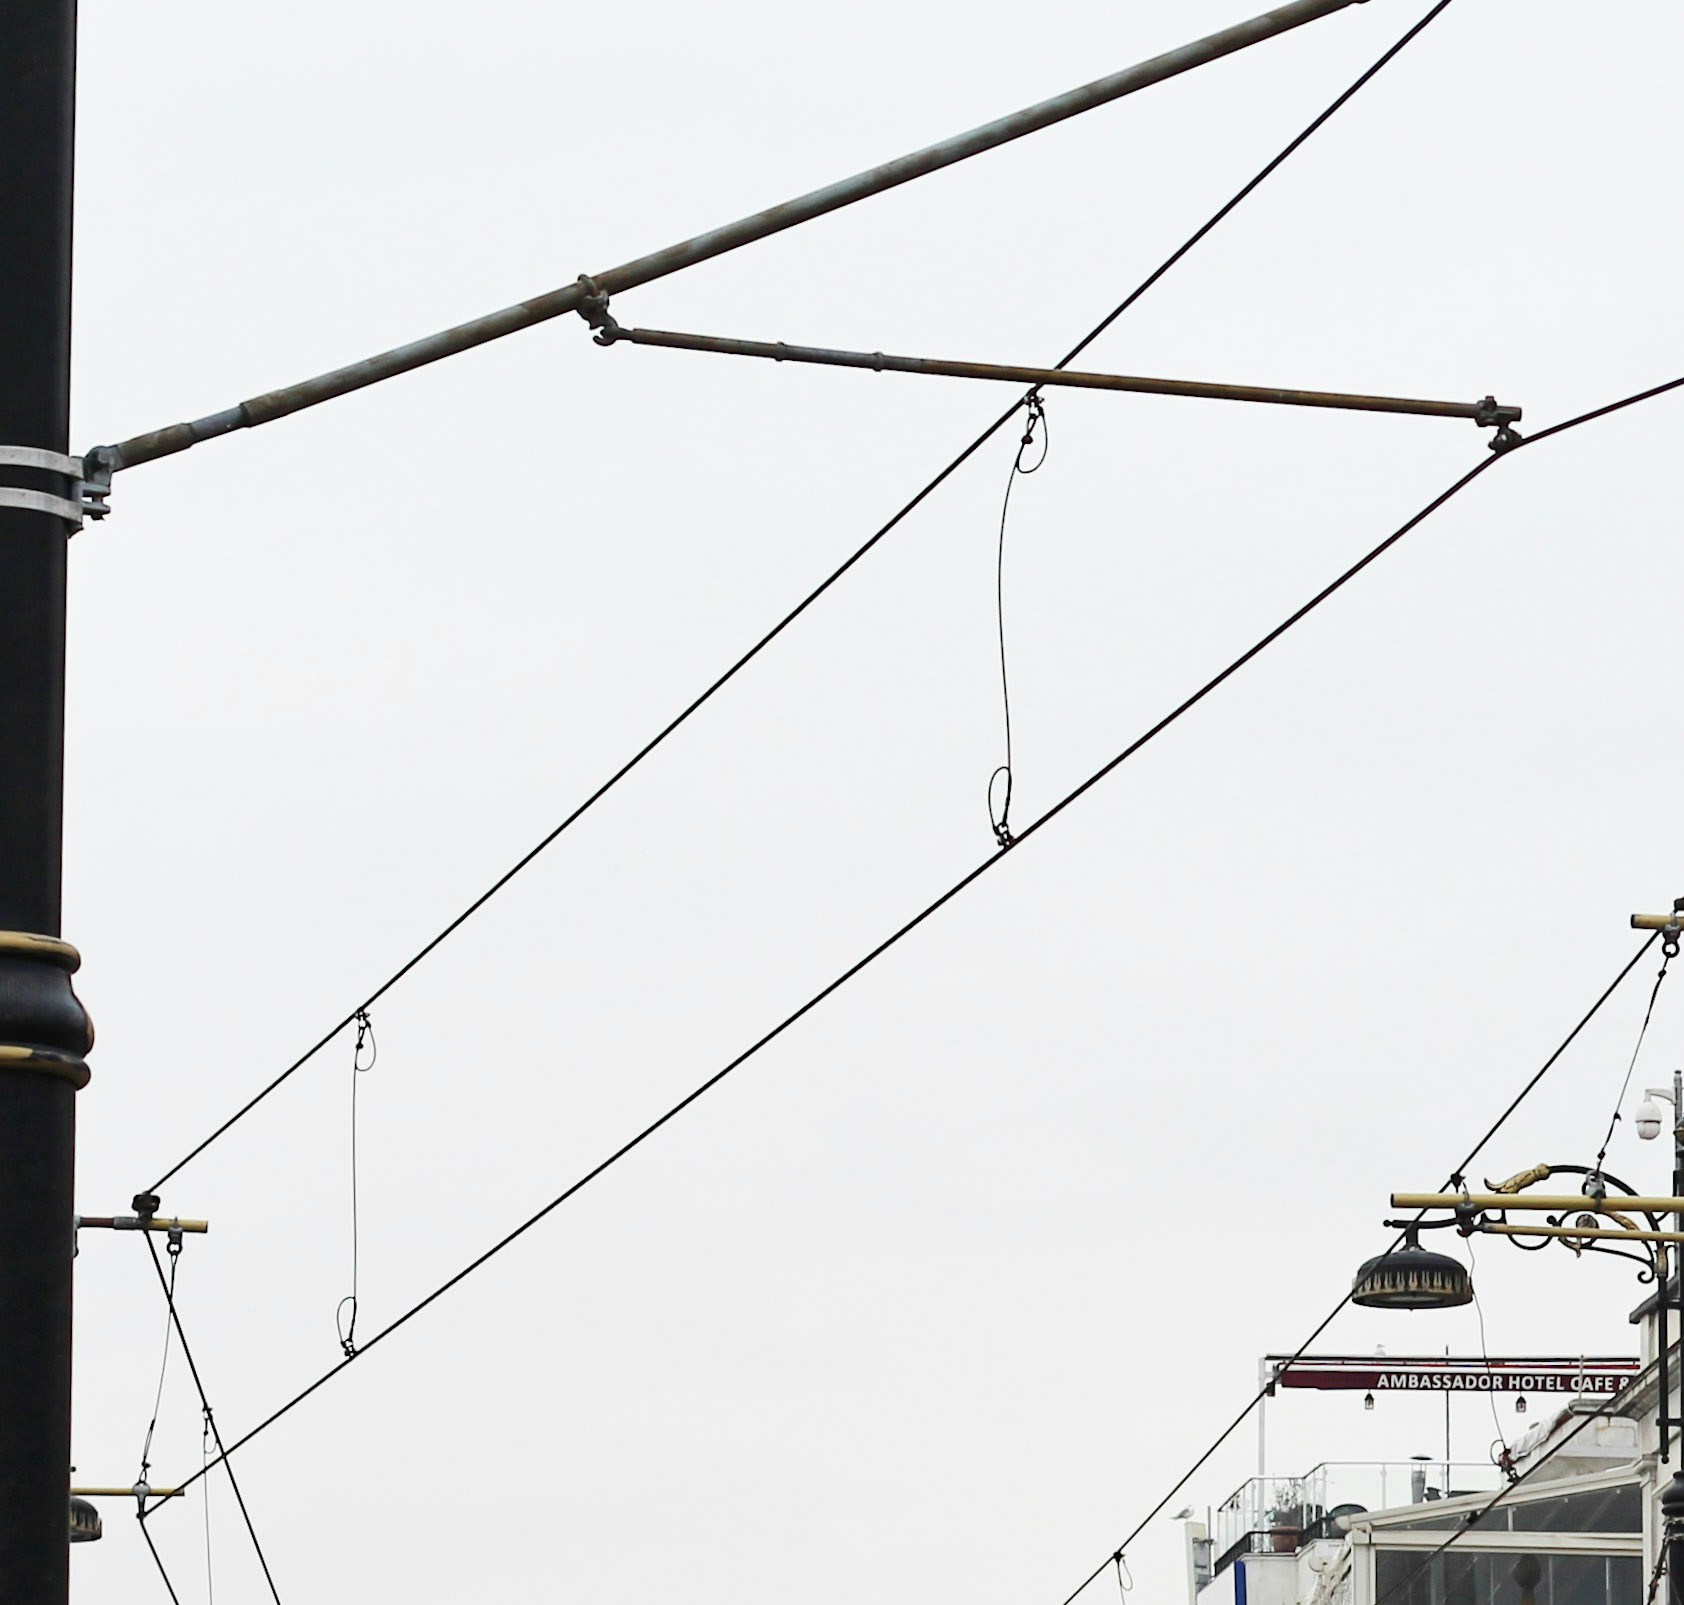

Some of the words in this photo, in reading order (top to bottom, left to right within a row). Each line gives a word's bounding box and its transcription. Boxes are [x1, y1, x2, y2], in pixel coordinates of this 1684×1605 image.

[1377, 1373, 1503, 1390] AMBASSADOR
[1509, 1375, 1564, 1391] HOTEL
[1571, 1376, 1619, 1391] CAFE
